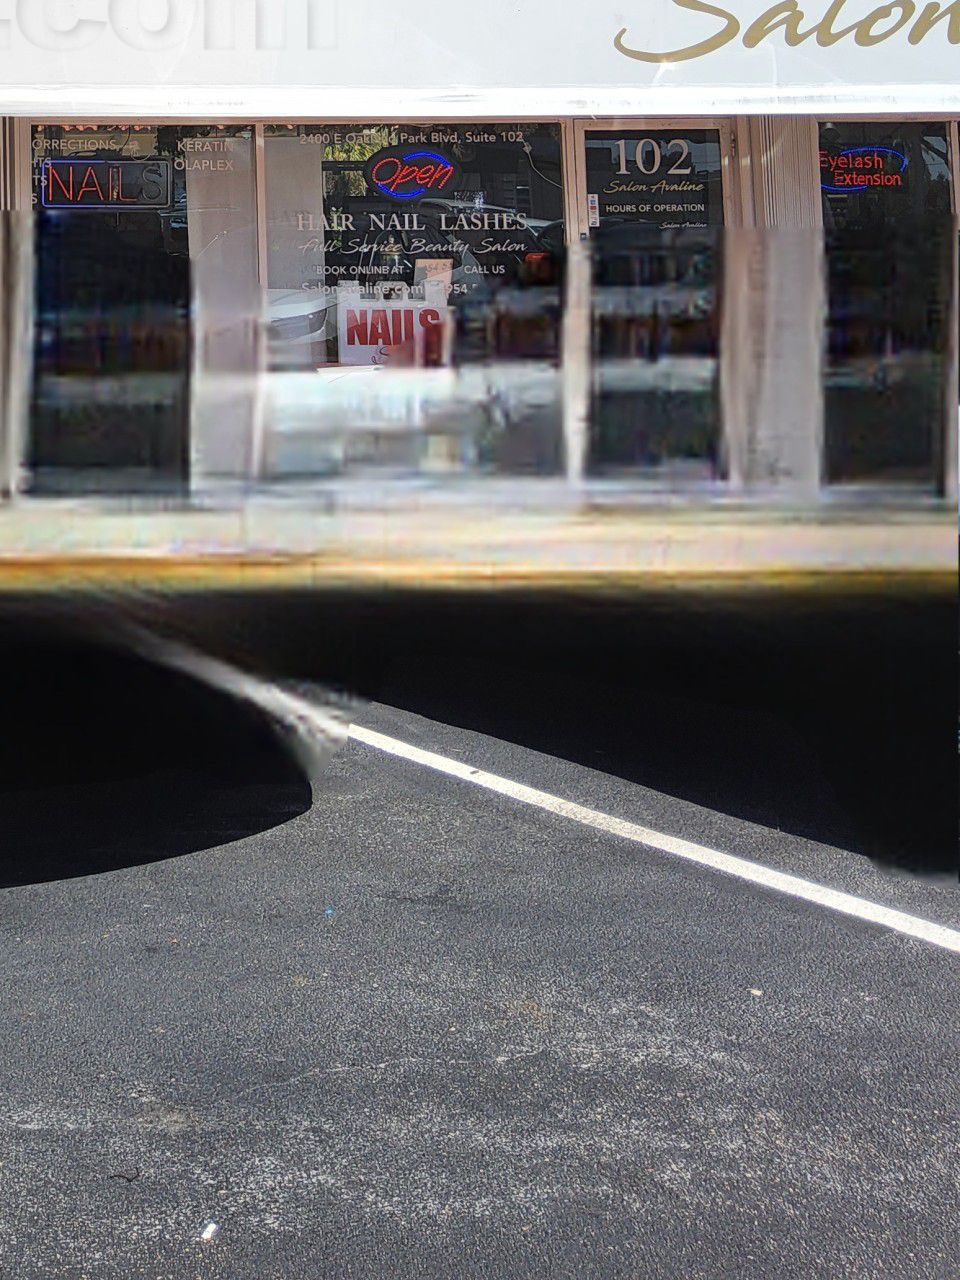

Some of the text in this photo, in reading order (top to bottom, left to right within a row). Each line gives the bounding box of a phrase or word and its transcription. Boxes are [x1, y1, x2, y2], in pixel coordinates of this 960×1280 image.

[299, 132, 331, 145] 2400
[334, 132, 342, 144] E
[400, 132, 428, 144] Park
[430, 131, 461, 144] Blvd,
[465, 131, 497, 143] Suite
[500, 131, 524, 142] 102
[177, 140, 234, 153] KERATIN
[614, 138, 692, 175] 102
[818, 151, 883, 171] Eyelash
[173, 158, 234, 171] OLAPLEX
[47, 162, 164, 202] NAILS
[372, 157, 455, 192] Open
[833, 170, 902, 186] Extension
[603, 179, 648, 194] Salon
[605, 203, 705, 213] HOURS OF OPERATION
[297, 211, 528, 231] HAIR NAIL LASHES
[297, 237, 529, 256] Full Service Beauty Salon
[316, 265, 347, 276] BOOK
[390, 265, 405, 276] AT
[464, 265, 488, 275] CALL
[490, 265, 506, 275] US
